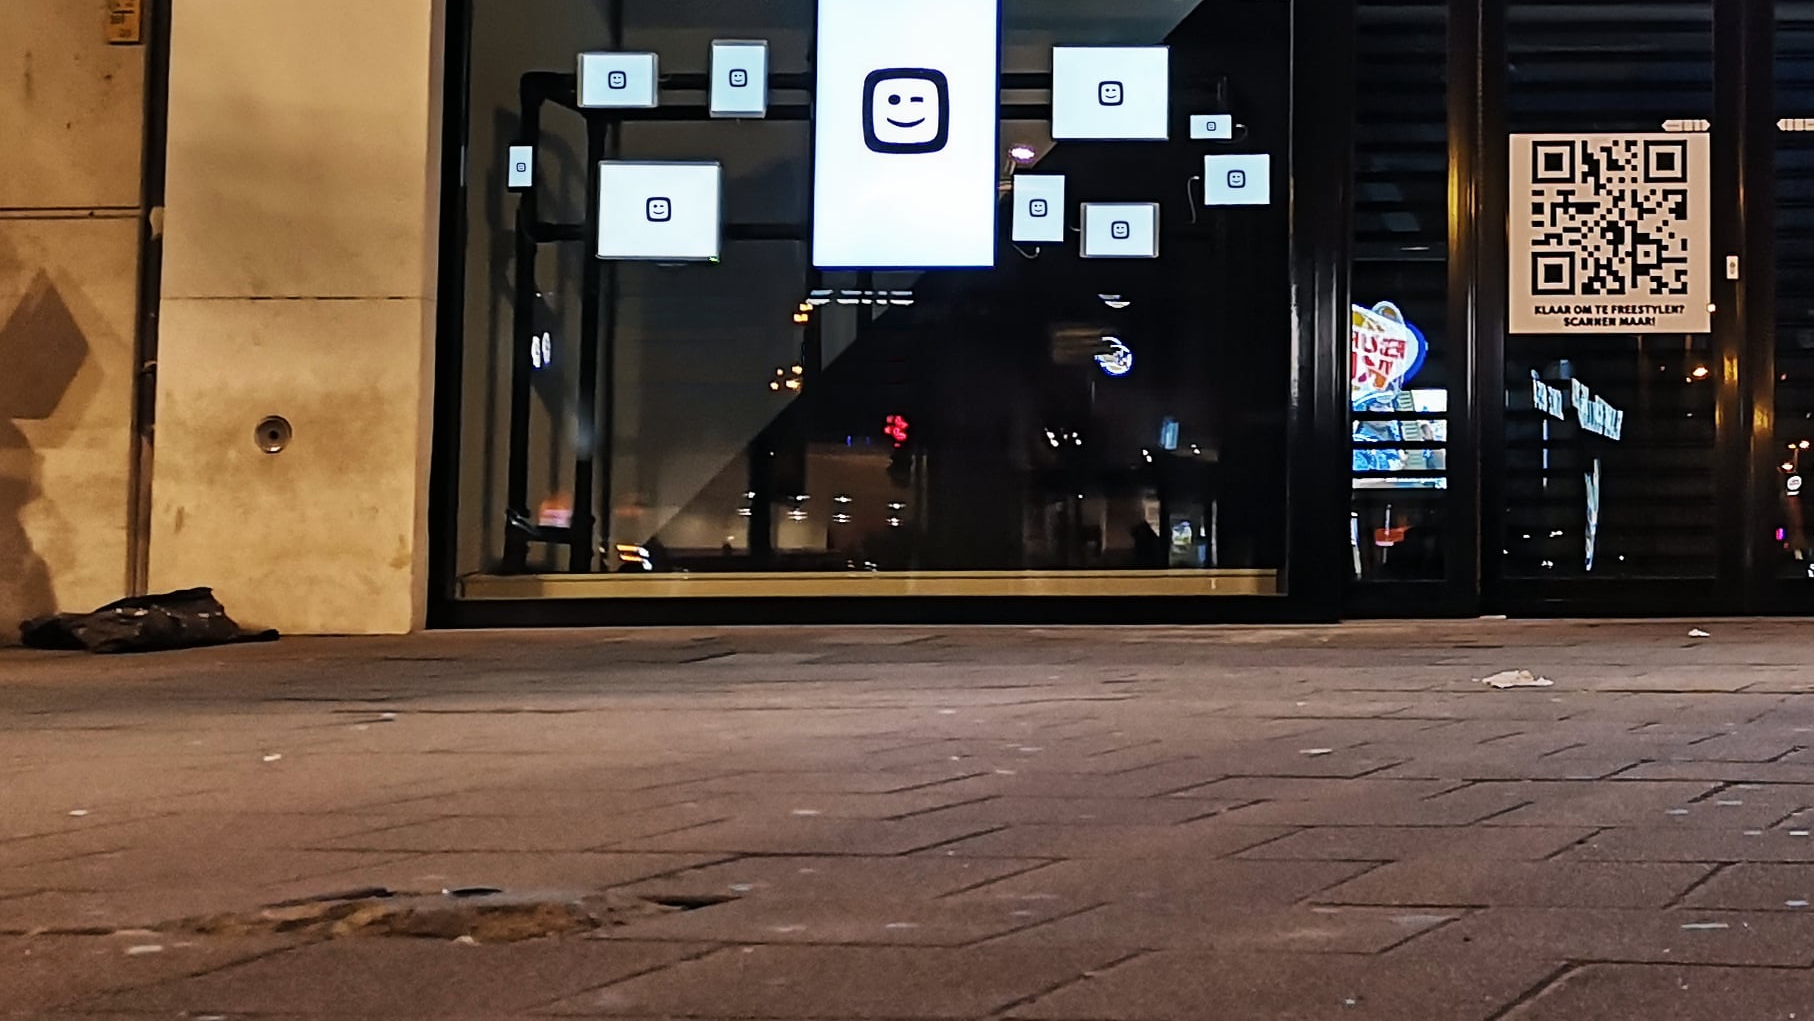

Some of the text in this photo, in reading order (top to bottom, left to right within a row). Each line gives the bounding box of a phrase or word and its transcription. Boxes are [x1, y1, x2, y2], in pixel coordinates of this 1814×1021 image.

[1534, 305, 1685, 315] KLAAR OM TE FREESTYLEN?
[1563, 317, 1656, 327] SCANNEN MAAR!
